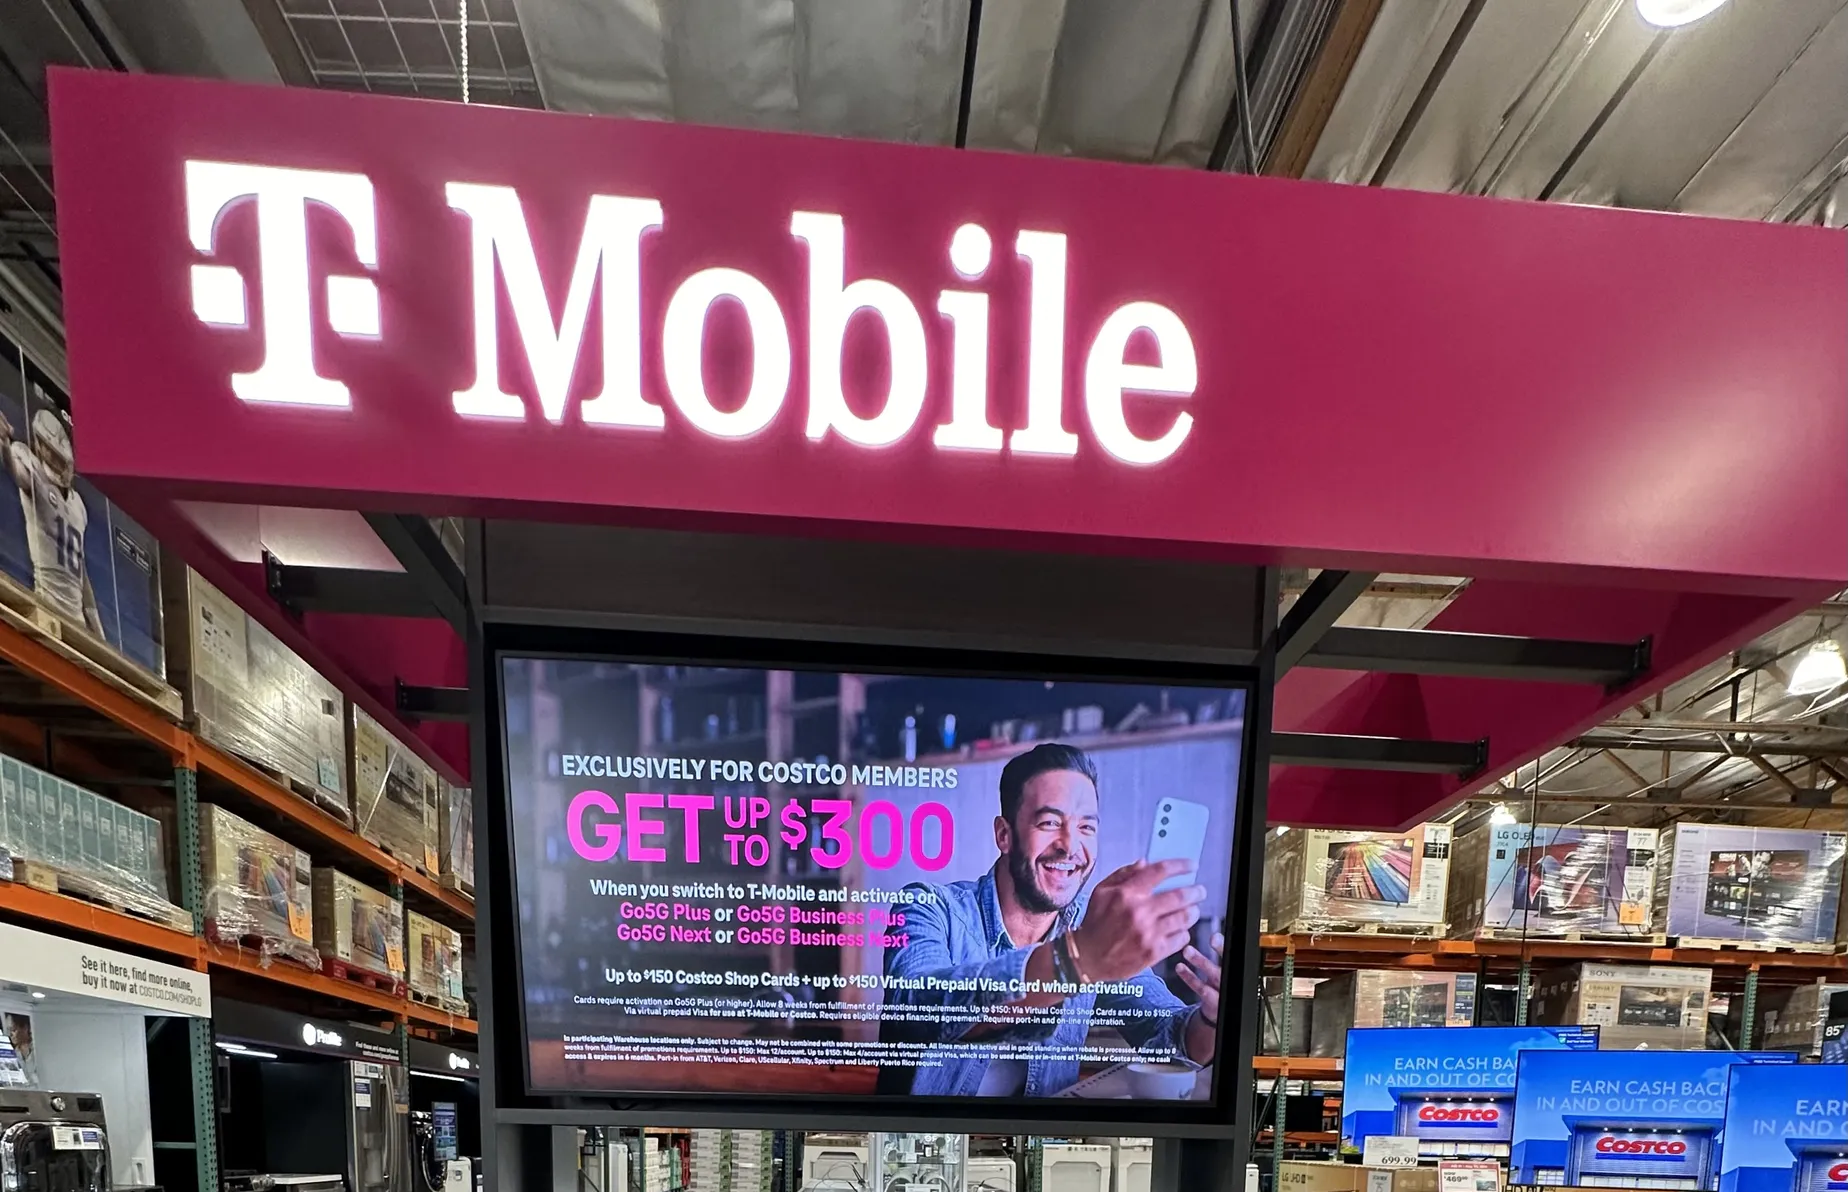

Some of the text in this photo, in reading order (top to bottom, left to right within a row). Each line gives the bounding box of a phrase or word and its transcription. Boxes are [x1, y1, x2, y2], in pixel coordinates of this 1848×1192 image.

[447, 181, 1198, 466] Mobile
[562, 754, 958, 789] EXCLUSIVELY FOR COSTCO MEMBERS
[724, 796, 770, 828] UP
[566, 790, 715, 863] GET
[780, 798, 954, 871] $300
[1497, 831, 1509, 840] LG
[724, 834, 770, 866] TO
[590, 879, 937, 905] When you switch to T-Mobile and activate on
[620, 902, 906, 927] Go5G Plus or Go5G Business Plus
[617, 924, 909, 949] Go5G Next or Go5G Business Next
[81, 955, 193, 993] See it here, find more online,
[82, 972, 99, 989] buy
[100, 975, 108, 989] it
[109, 979, 127, 992] now
[129, 984, 138, 995] at
[605, 968, 1144, 998] Up to $150 Costco Shop Cards + up to $150 Virtual Prepaid Visa Card when activating
[1589, 969, 1616, 977] SONY
[573, 995, 596, 1004] Cards
[597, 996, 624, 1006] require
[625, 997, 662, 1006] activation
[674, 998, 696, 1006] Go5G
[697, 998, 713, 1007] Plus
[714, 998, 726, 1008] (or
[726, 998, 756, 1009] higher).
[756, 999, 777, 1008] Allow
[784, 1000, 808, 1009] weeks
[809, 1000, 827, 1009] from
[868, 1002, 876, 1010] of
[876, 1002, 918, 1012] promotions
[918, 1004, 969, 1013] requirements.
[969, 1005, 980, 1014] Up
[990, 1005, 1011, 1014] $150:
[1012, 1006, 1024, 1014] Via
[1024, 1006, 1049, 1015] Virtual
[1050, 1007, 1075, 1015] Costco
[1076, 1007, 1095, 1017] Shop
[1095, 1008, 1116, 1016] Cards
[1118, 1008, 1132, 1017] and
[1133, 1009, 1143, 1018] Up
[1144, 1009, 1152, 1017] to
[624, 1006, 636, 1015] Via
[637, 1007, 662, 1015] virtual
[663, 1007, 692, 1017] prepaid
[692, 1008, 709, 1016] Visa
[709, 1008, 721, 1017] for
[736, 1009, 746, 1017] at
[746, 1009, 779, 1018] T-Mobile
[789, 1010, 818, 1019] Costco.
[819, 1011, 852, 1020] Requires
[852, 1011, 880, 1021] eligible
[881, 1012, 905, 1021] device
[906, 1012, 940, 1023] financing
[940, 1014, 982, 1024] agreement.
[982, 1015, 1014, 1024] Requires
[1015, 1015, 1040, 1025] port-in
[1041, 1016, 1055, 1024] and
[1056, 1016, 1081, 1025] on-line
[1082, 1017, 1125, 1027] registration.
[1394, 1056, 1517, 1070] EARN CASH BA
[1364, 1073, 1381, 1086] IN
[1384, 1073, 1421, 1086] AND
[1426, 1072, 1463, 1086] OUT
[1468, 1072, 1491, 1086] OF
[1570, 1080, 1621, 1094] EARN
[1625, 1080, 1676, 1096] CASH
[1418, 1106, 1499, 1121] COSTCO
[1536, 1097, 1725, 1114] IN AND OUT OF COS
[1752, 1119, 1776, 1136] IN
[1780, 1120, 1834, 1137] AND
[1596, 1136, 1687, 1155] COSTCO
[1381, 1156, 1417, 1165] 699.99
